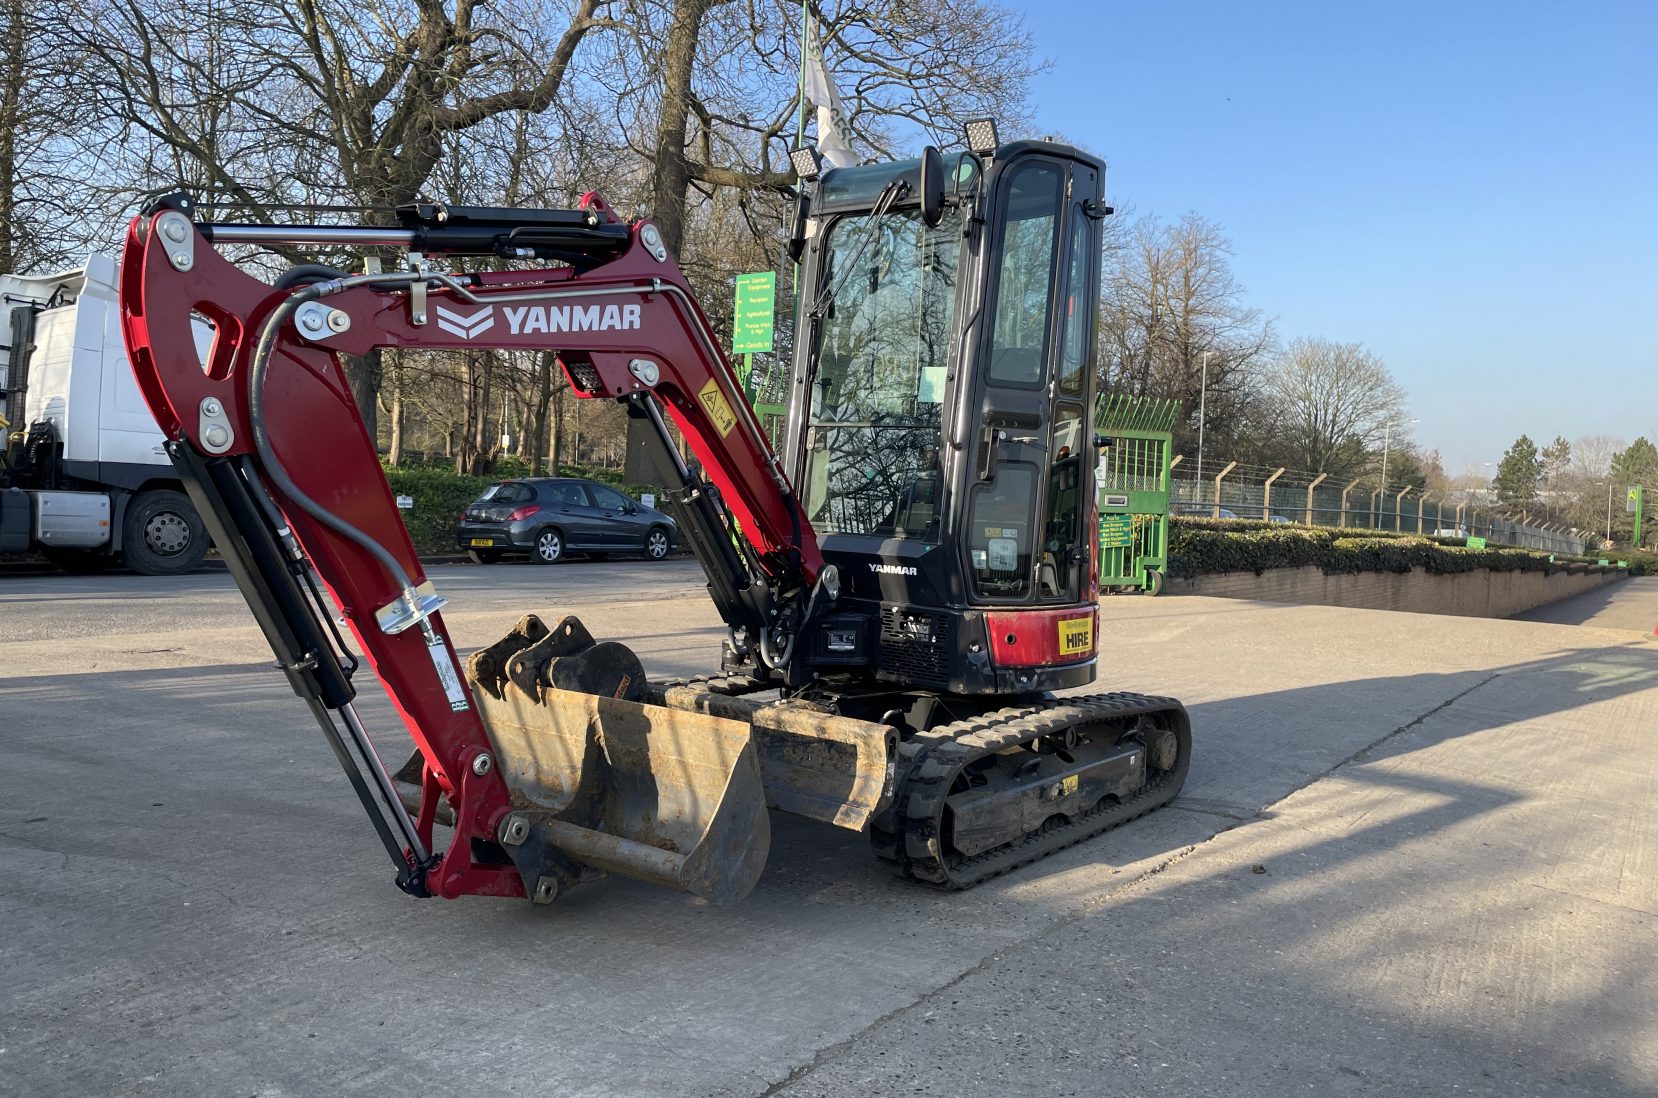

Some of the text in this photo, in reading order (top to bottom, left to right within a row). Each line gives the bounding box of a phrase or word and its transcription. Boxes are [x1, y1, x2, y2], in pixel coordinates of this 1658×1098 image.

[503, 304, 641, 335] YANMAR
[868, 563, 917, 576] YANMAR
[1066, 631, 1089, 649] HIRE
